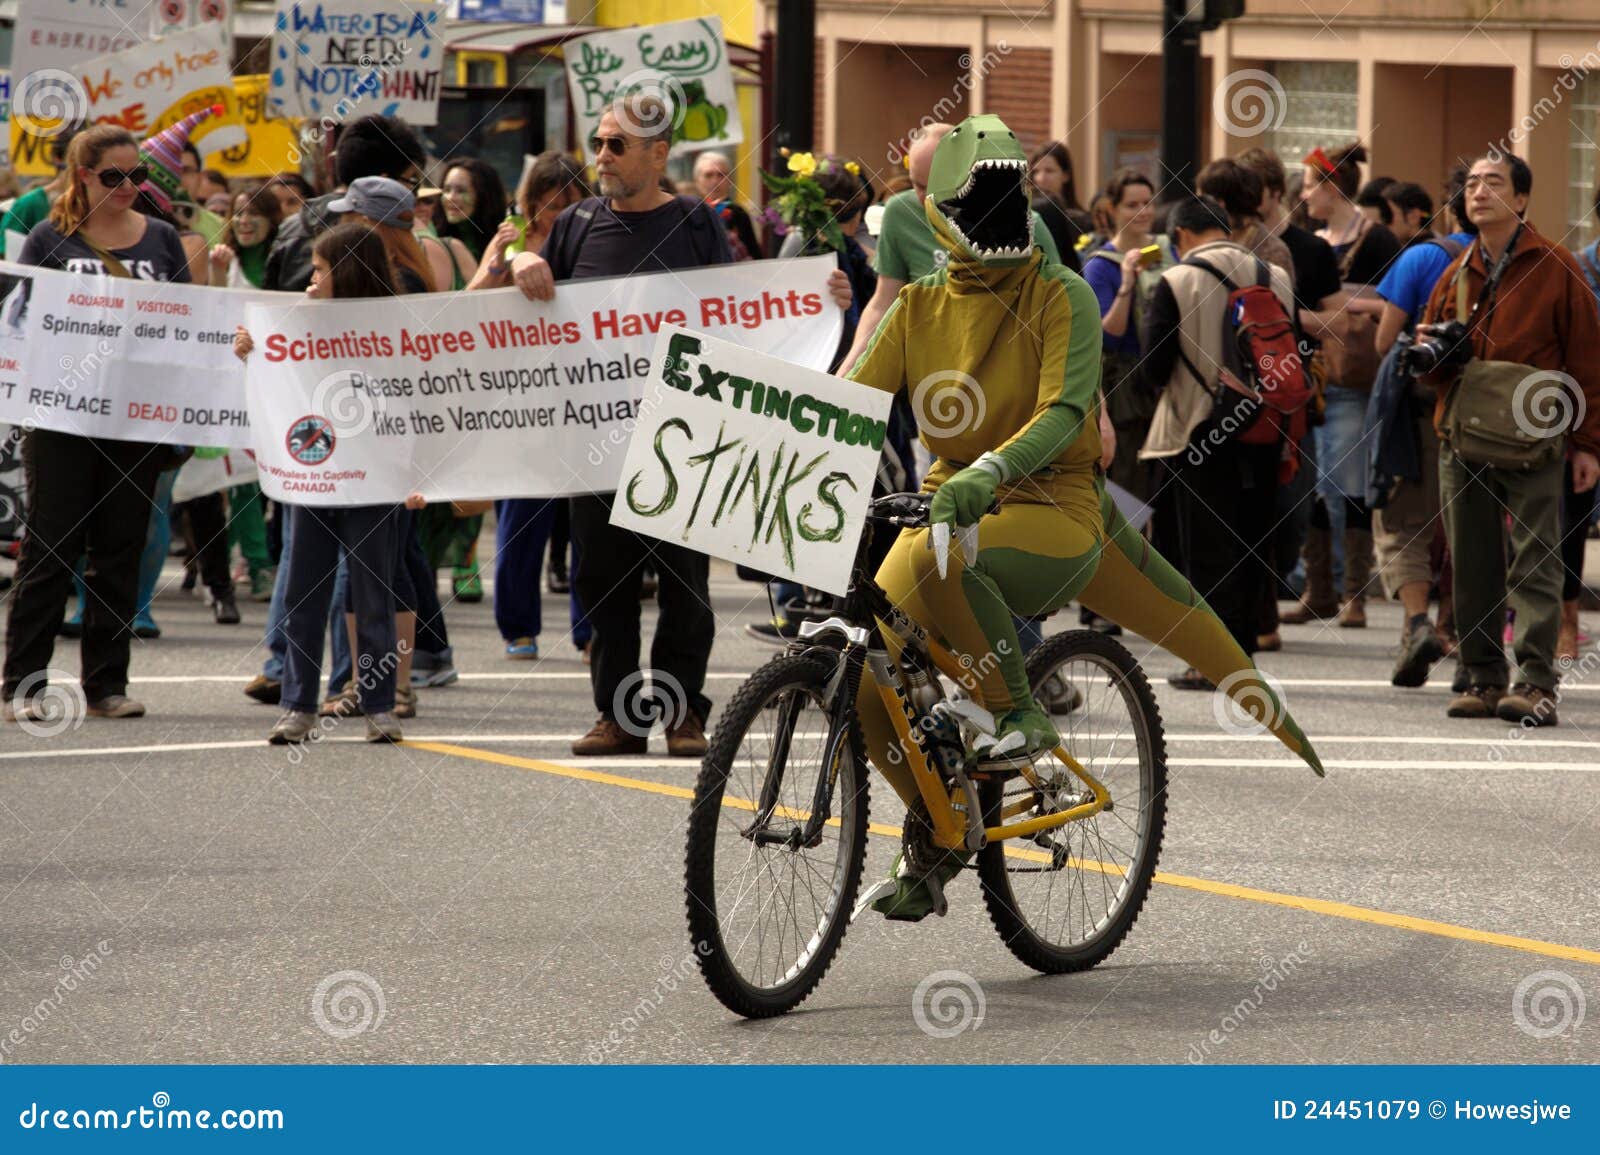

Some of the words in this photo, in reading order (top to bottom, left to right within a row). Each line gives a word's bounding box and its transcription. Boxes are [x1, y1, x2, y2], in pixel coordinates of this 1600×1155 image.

[637, 33, 709, 71] Easy
[83, 69, 122, 105] We
[296, 67, 355, 96] NOT
[382, 70, 440, 101] WANT
[67, 293, 125, 310] AQUARIUM
[136, 299, 193, 316] VISITORS:
[42, 313, 122, 338] Spinnaker
[134, 322, 166, 340] died
[174, 327, 190, 342] to
[264, 330, 394, 363] Scientists
[400, 328, 476, 362] Agree
[480, 316, 581, 350] Whales
[593, 308, 687, 341] Have
[700, 289, 823, 329] Rights
[351, 372, 414, 399] Please
[418, 367, 475, 396] don't
[480, 362, 560, 395] support
[564, 352, 650, 385] whale
[662, 333, 886, 450] EXTINCTION
[28, 388, 113, 416] REPLACE
[127, 402, 178, 423] DEAD
[183, 407, 250, 428] DOLPHI
[373, 410, 406, 437] like
[411, 411, 445, 435] the
[448, 405, 556, 432] Vancouver
[283, 480, 337, 493] CANADA
[323, 470, 367, 481] Captivity
[626, 417, 858, 573] STINKS
